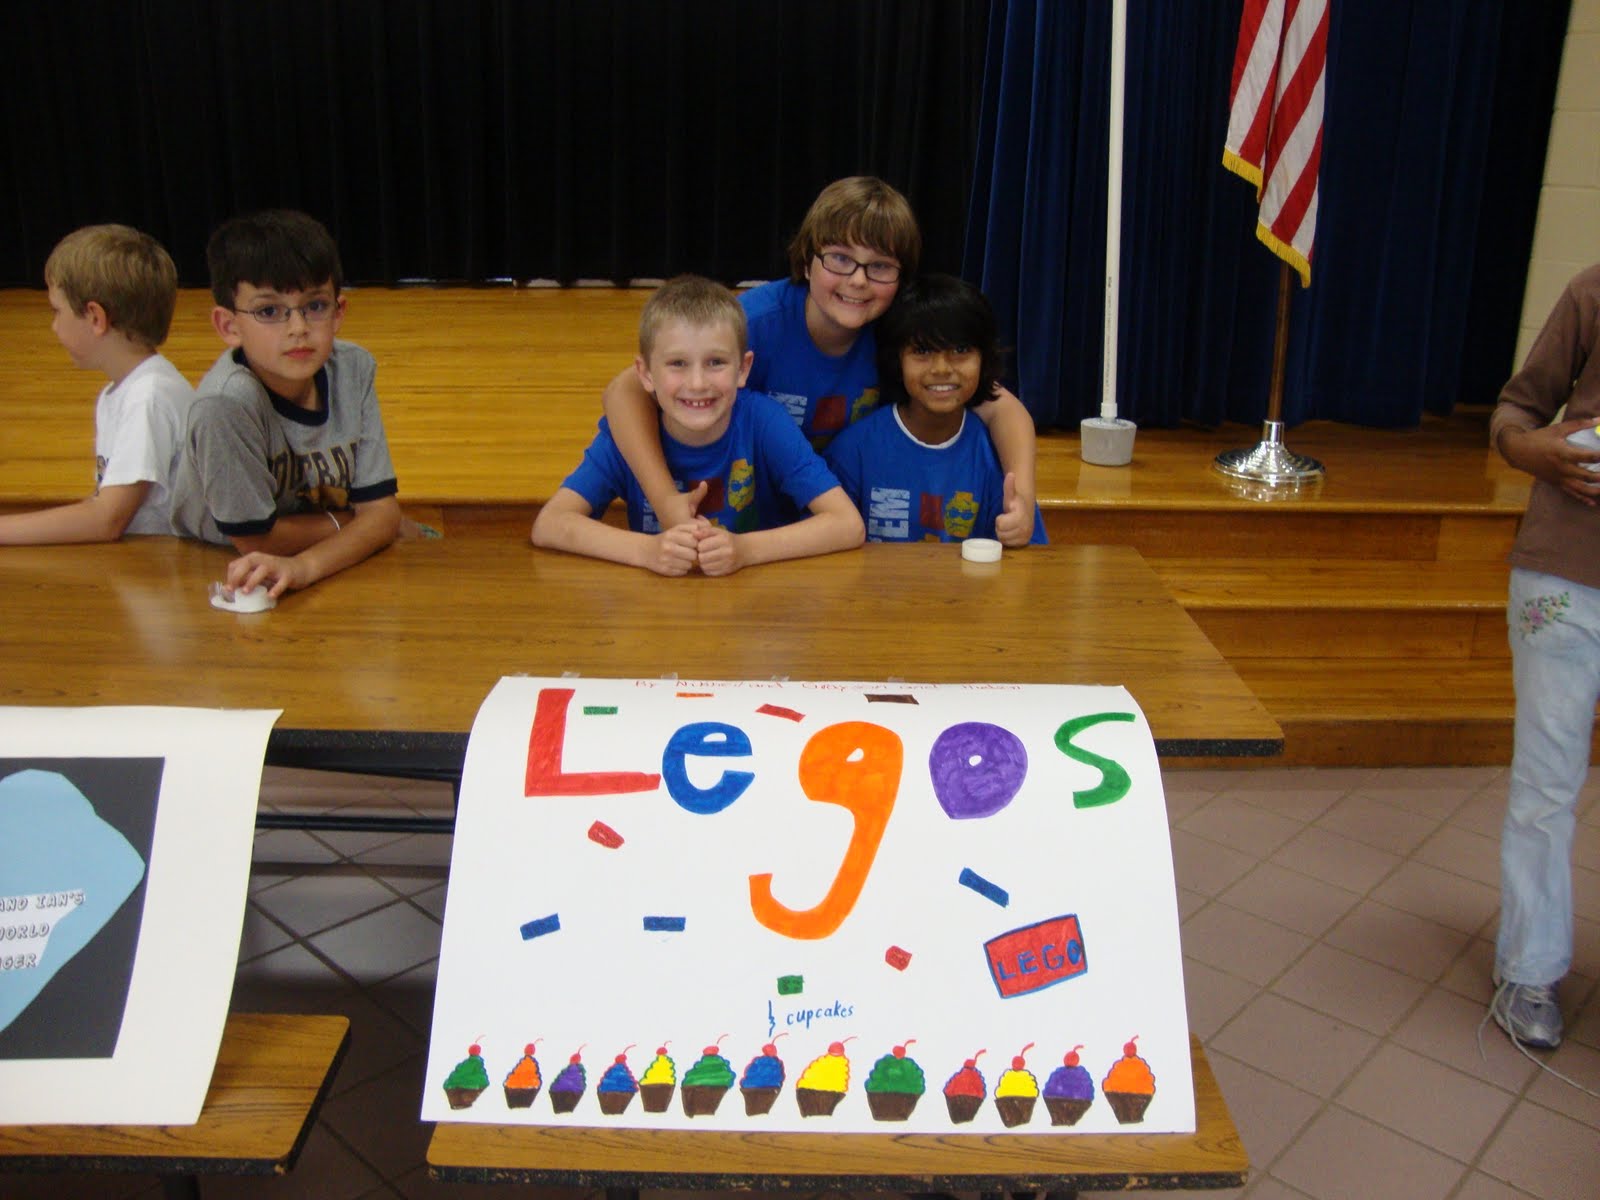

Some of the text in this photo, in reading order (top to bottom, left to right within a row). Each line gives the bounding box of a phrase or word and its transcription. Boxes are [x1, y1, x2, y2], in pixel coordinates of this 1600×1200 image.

[524, 687, 1136, 940] Legos
[36, 892, 84, 910] IAN'S
[0, 953, 37, 970] GER
[997, 938, 1082, 981] LEGO
[786, 1000, 854, 1029] cupcakes
